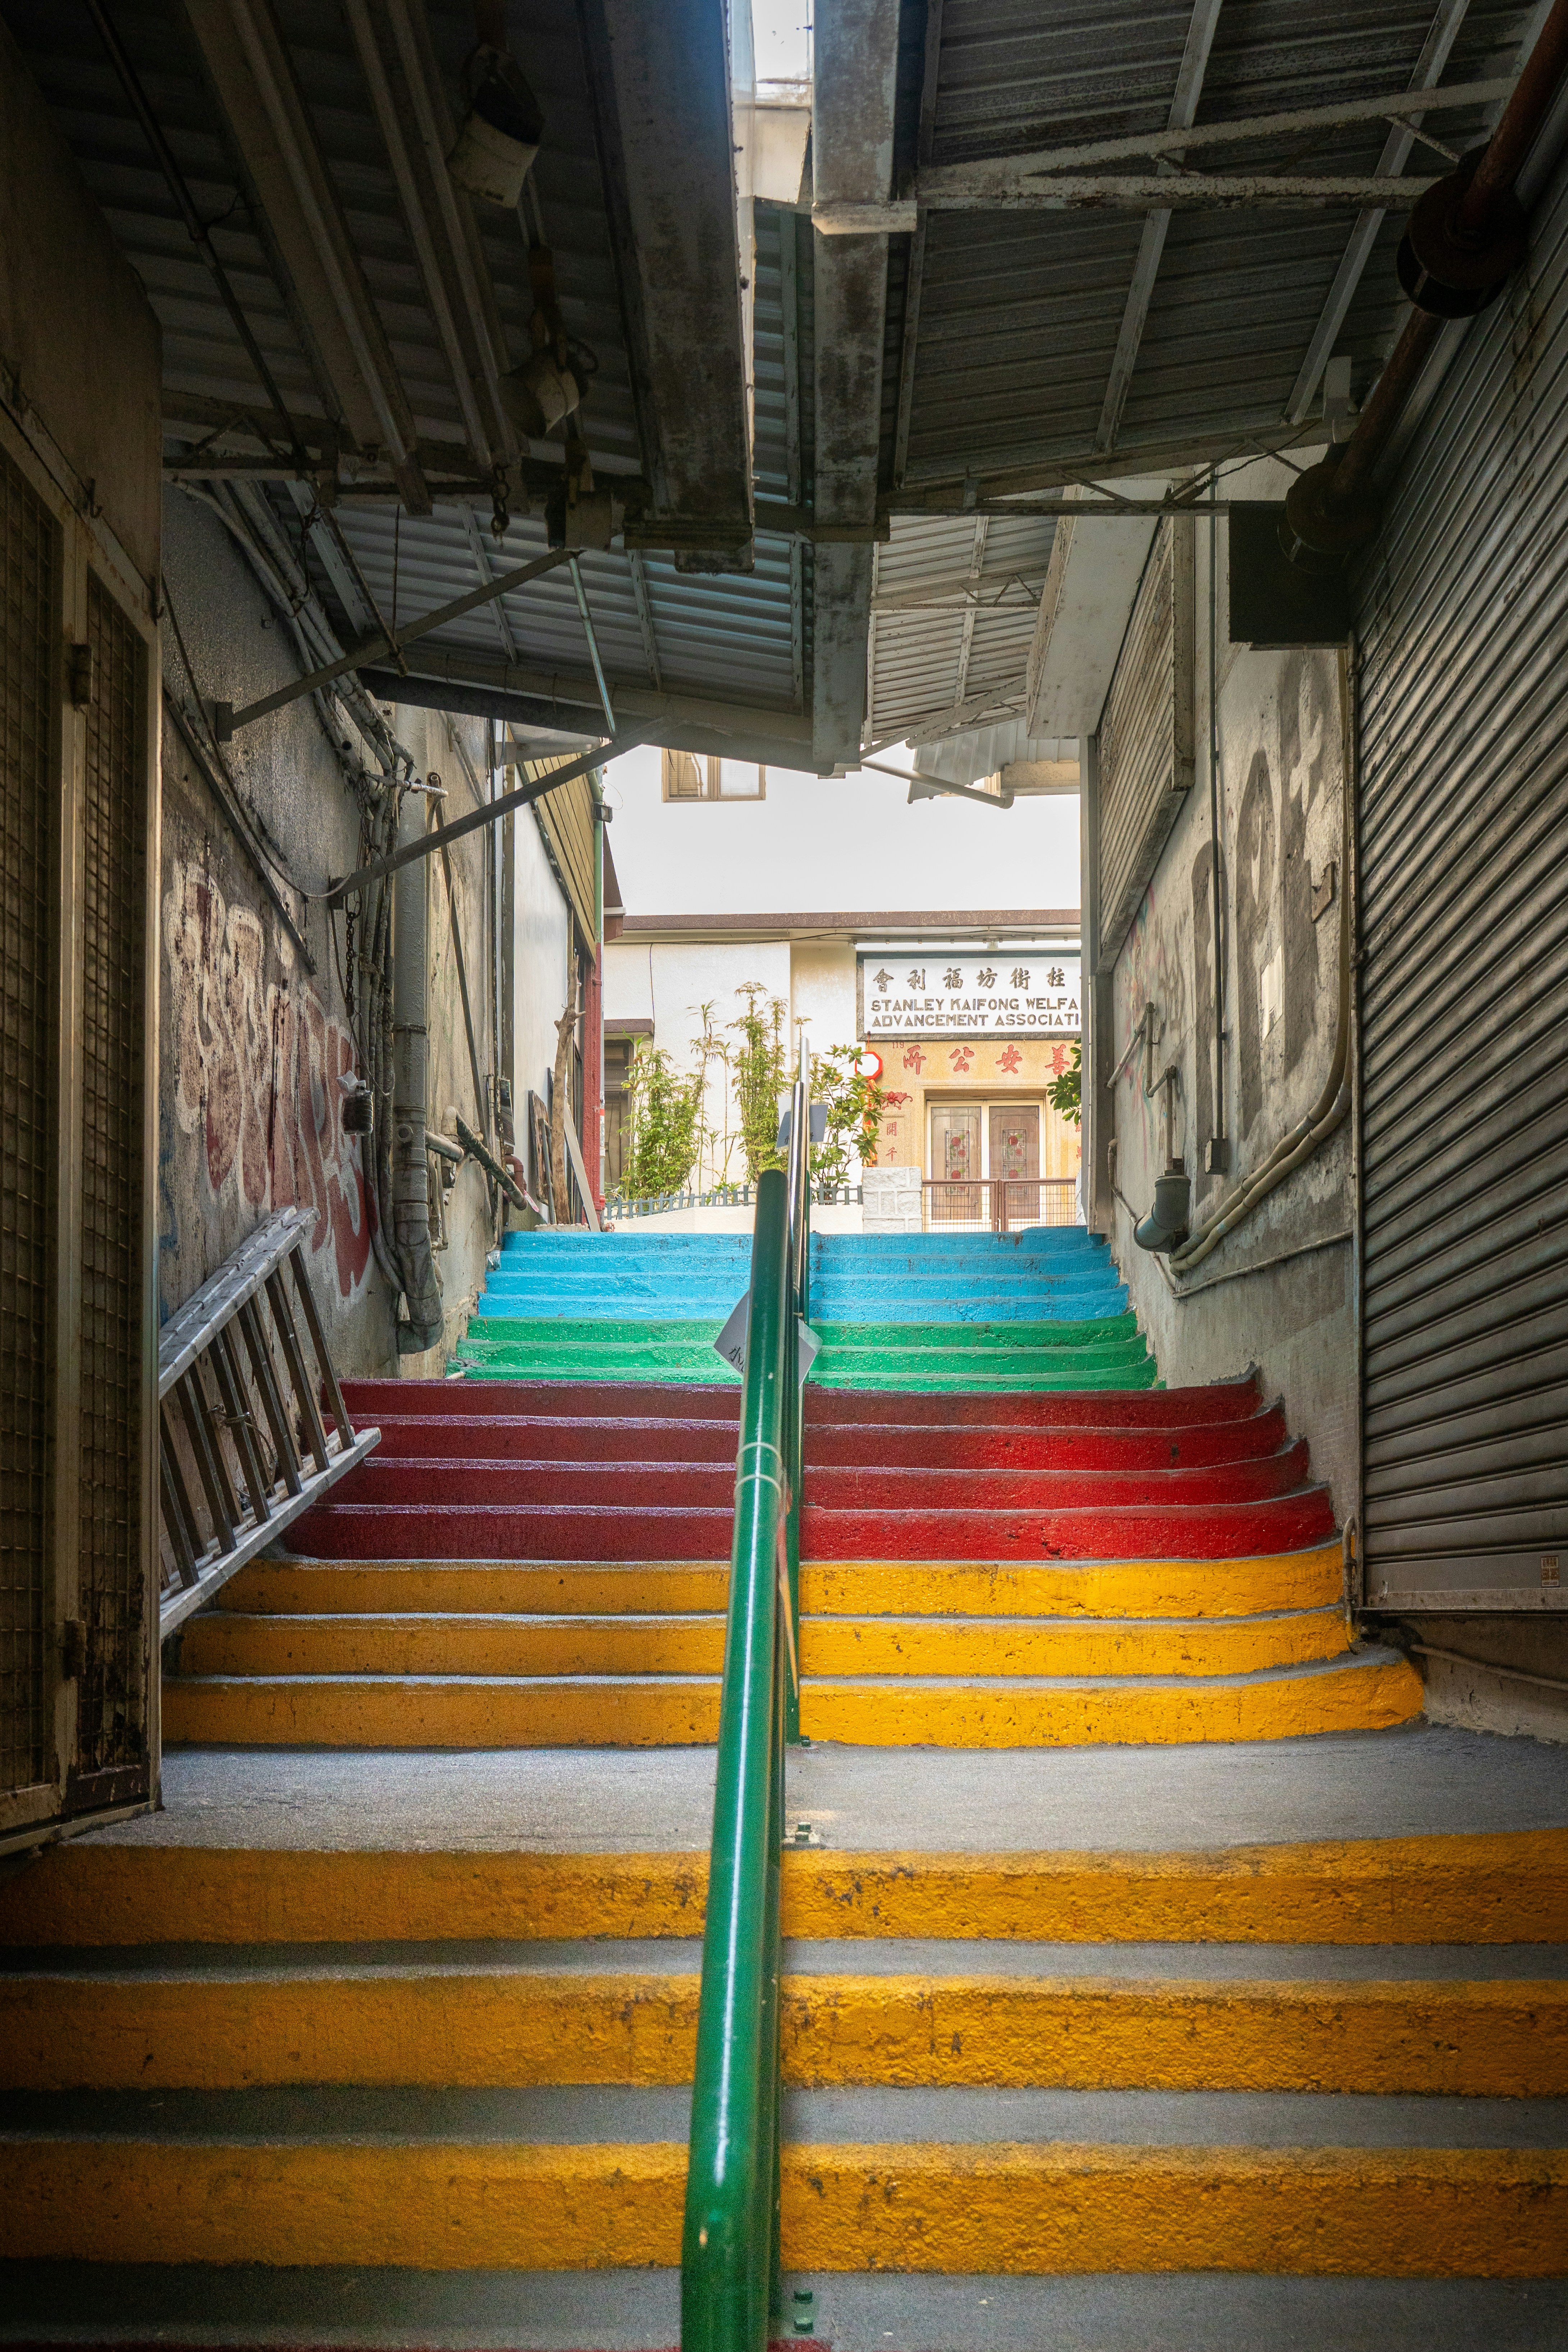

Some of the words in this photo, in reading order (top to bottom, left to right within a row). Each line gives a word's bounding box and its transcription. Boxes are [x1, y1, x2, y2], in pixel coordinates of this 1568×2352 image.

[871, 999, 944, 1011] STANLEY
[951, 998, 1019, 1010] KAIFONG
[1026, 998, 1078, 1010] WELFA
[872, 1014, 988, 1027] ADVANCEMENT
[995, 1013, 1079, 1026] ASSOCIATI
